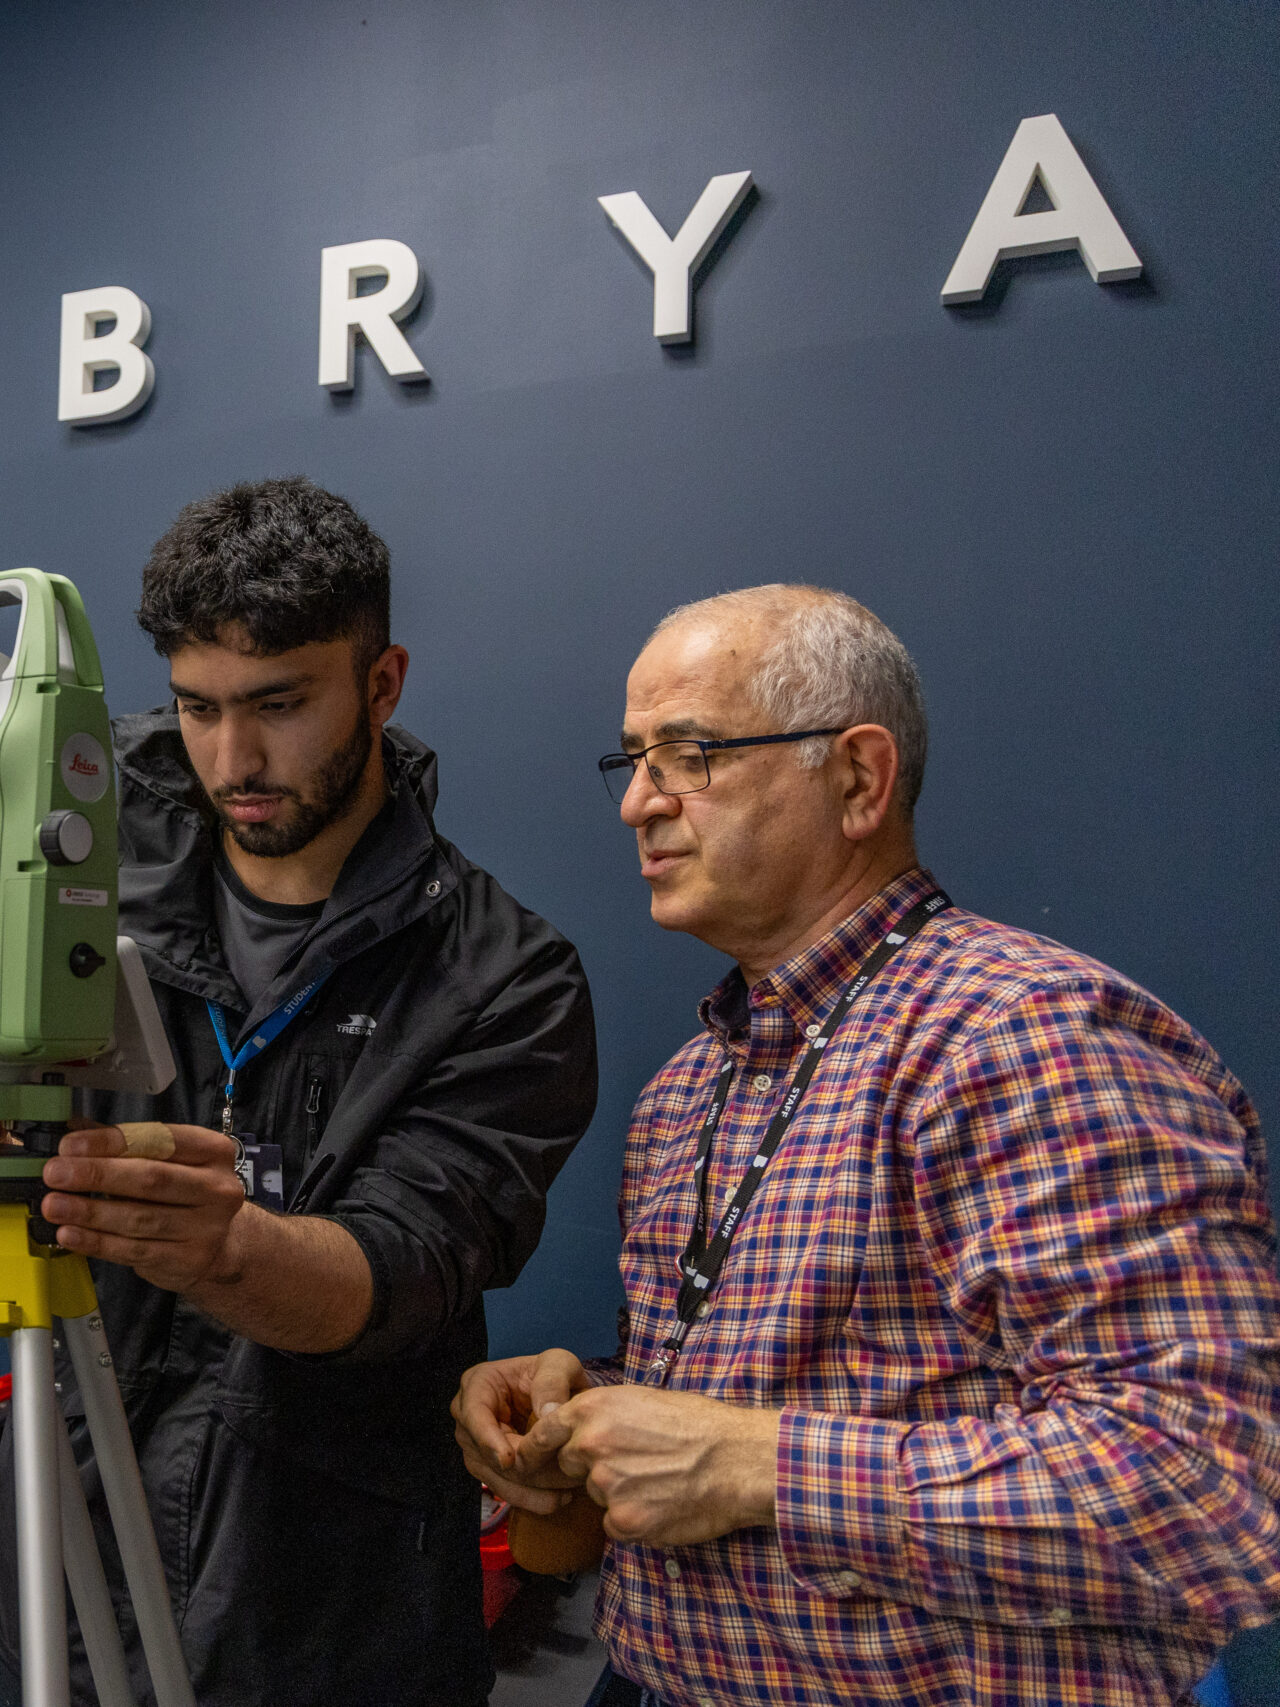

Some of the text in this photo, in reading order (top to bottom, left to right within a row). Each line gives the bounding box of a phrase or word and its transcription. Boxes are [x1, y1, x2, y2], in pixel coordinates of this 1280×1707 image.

[58, 113, 1144, 428] BRYA
[68, 753, 99, 776] Leica
[283, 981, 317, 1016] STUDEN
[845, 975, 869, 1002] STAFF
[336, 1024, 375, 1036] TRESPA
[781, 1086, 801, 1118] STAFF
[721, 1206, 740, 1239] STAFF
